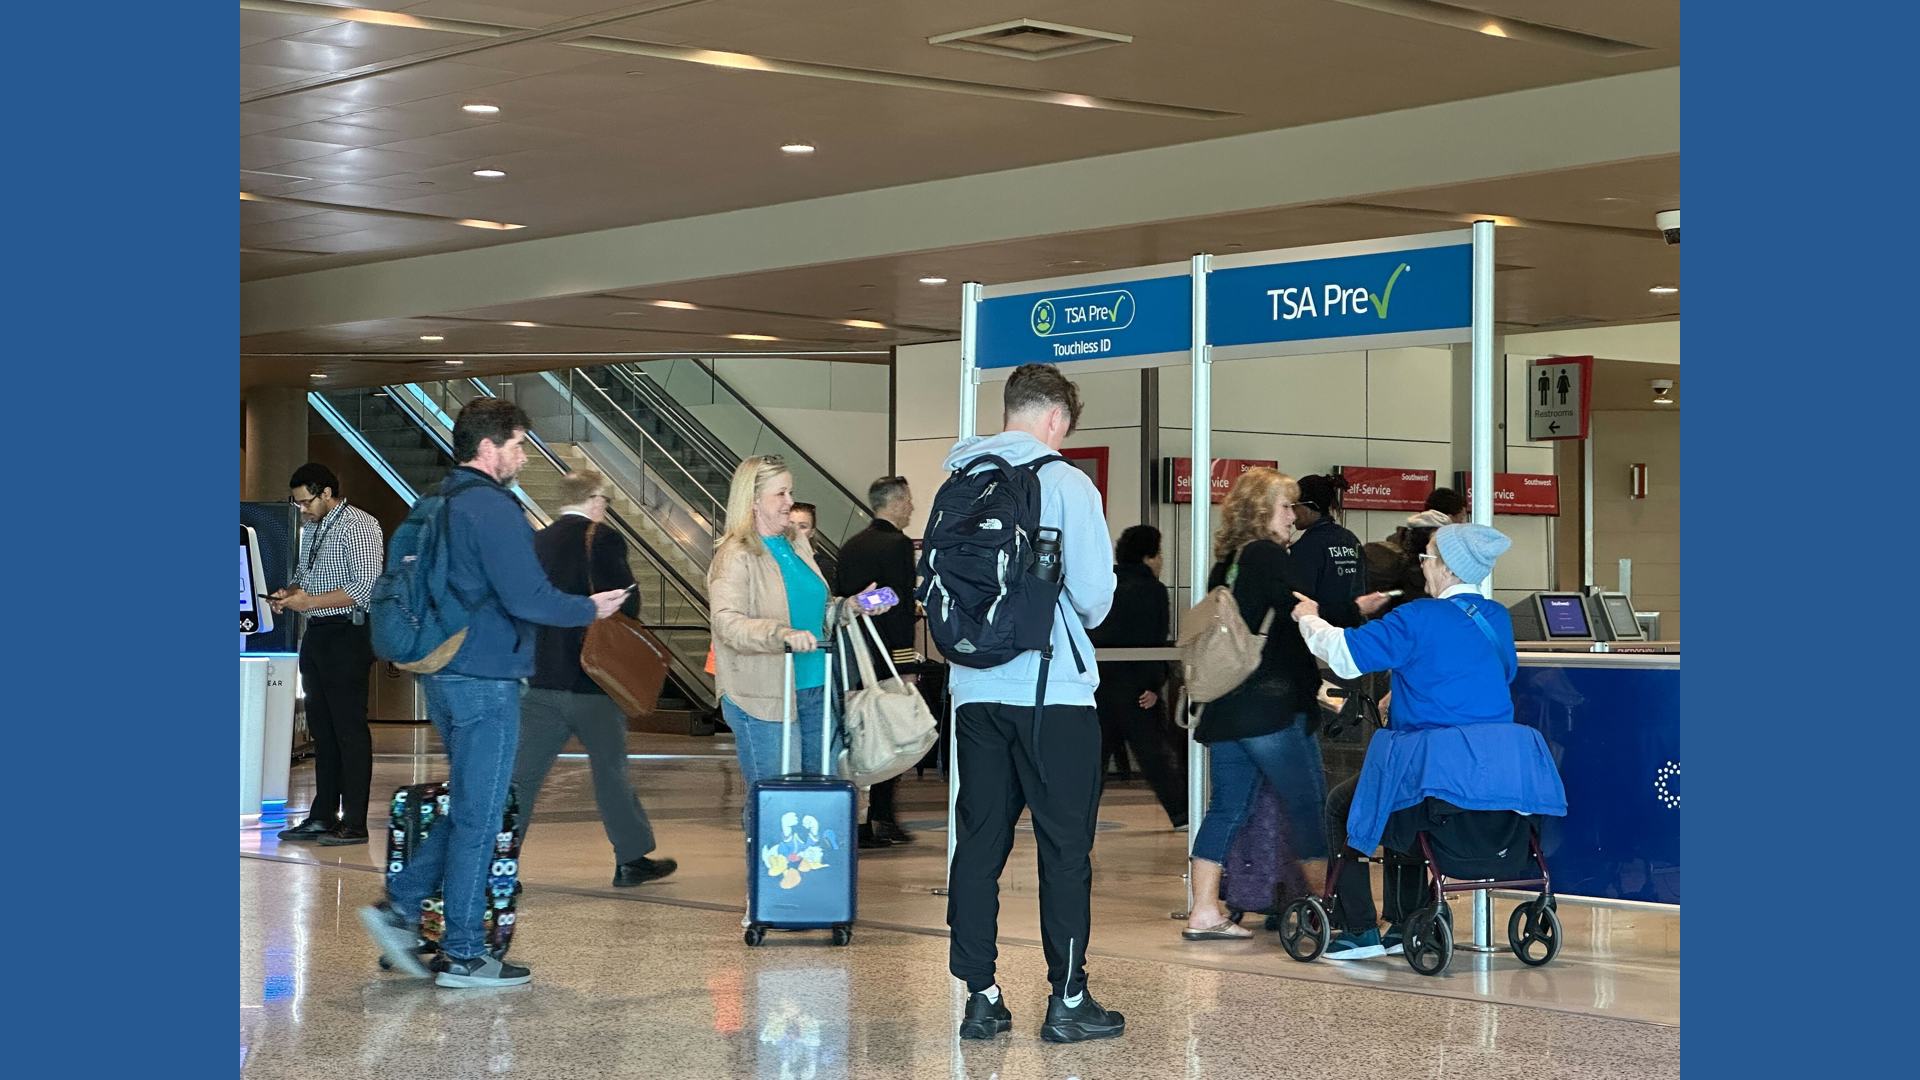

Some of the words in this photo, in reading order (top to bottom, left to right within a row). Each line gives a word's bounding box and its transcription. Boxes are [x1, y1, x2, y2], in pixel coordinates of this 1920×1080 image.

[1267, 286, 1317, 321] TSA
[1324, 284, 1368, 316] Pre
[1064, 307, 1087, 324] TSA
[1089, 305, 1108, 321] Pre
[1053, 340, 1099, 356] Touchless
[1100, 338, 1111, 352] ID
[1534, 409, 1574, 418] Restrooms
[1177, 475, 1230, 488] Selvice
[1401, 472, 1429, 481] Southwest
[1524, 478, 1552, 486] Southwest
[1347, 483, 1392, 496] elf-Service
[1328, 546, 1343, 557] TSA
